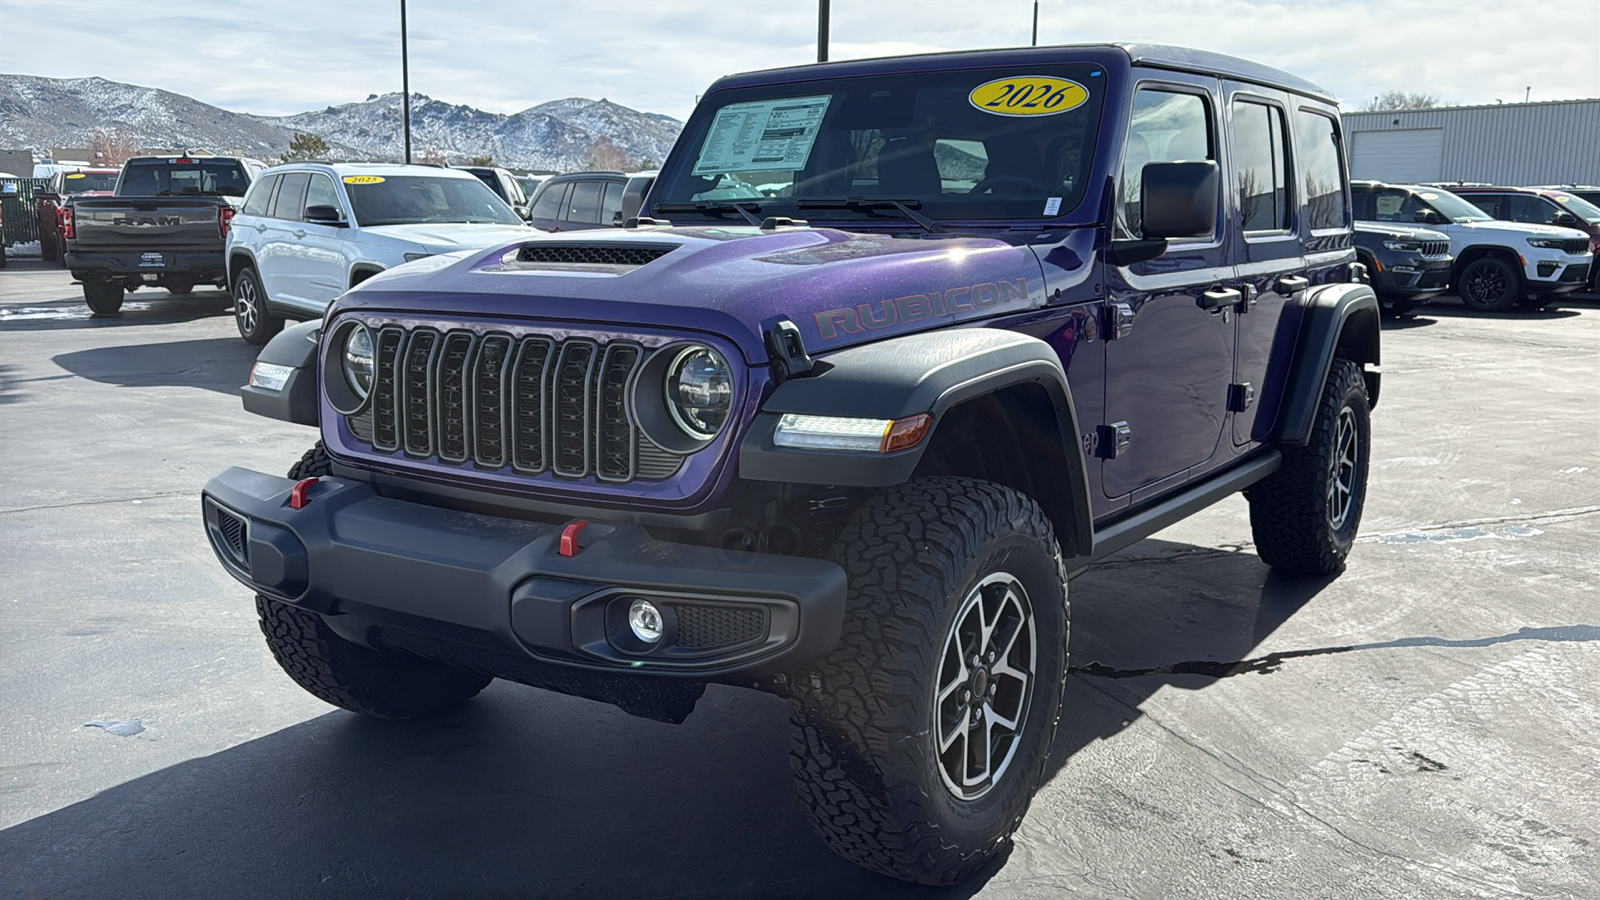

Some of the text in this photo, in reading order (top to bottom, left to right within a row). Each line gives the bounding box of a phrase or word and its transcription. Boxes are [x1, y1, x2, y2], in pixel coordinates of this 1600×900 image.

[984, 84, 1076, 108] 2026
[113, 217, 180, 226] RAM
[813, 277, 1029, 340] RUBICON
[1082, 431, 1100, 457] ep
